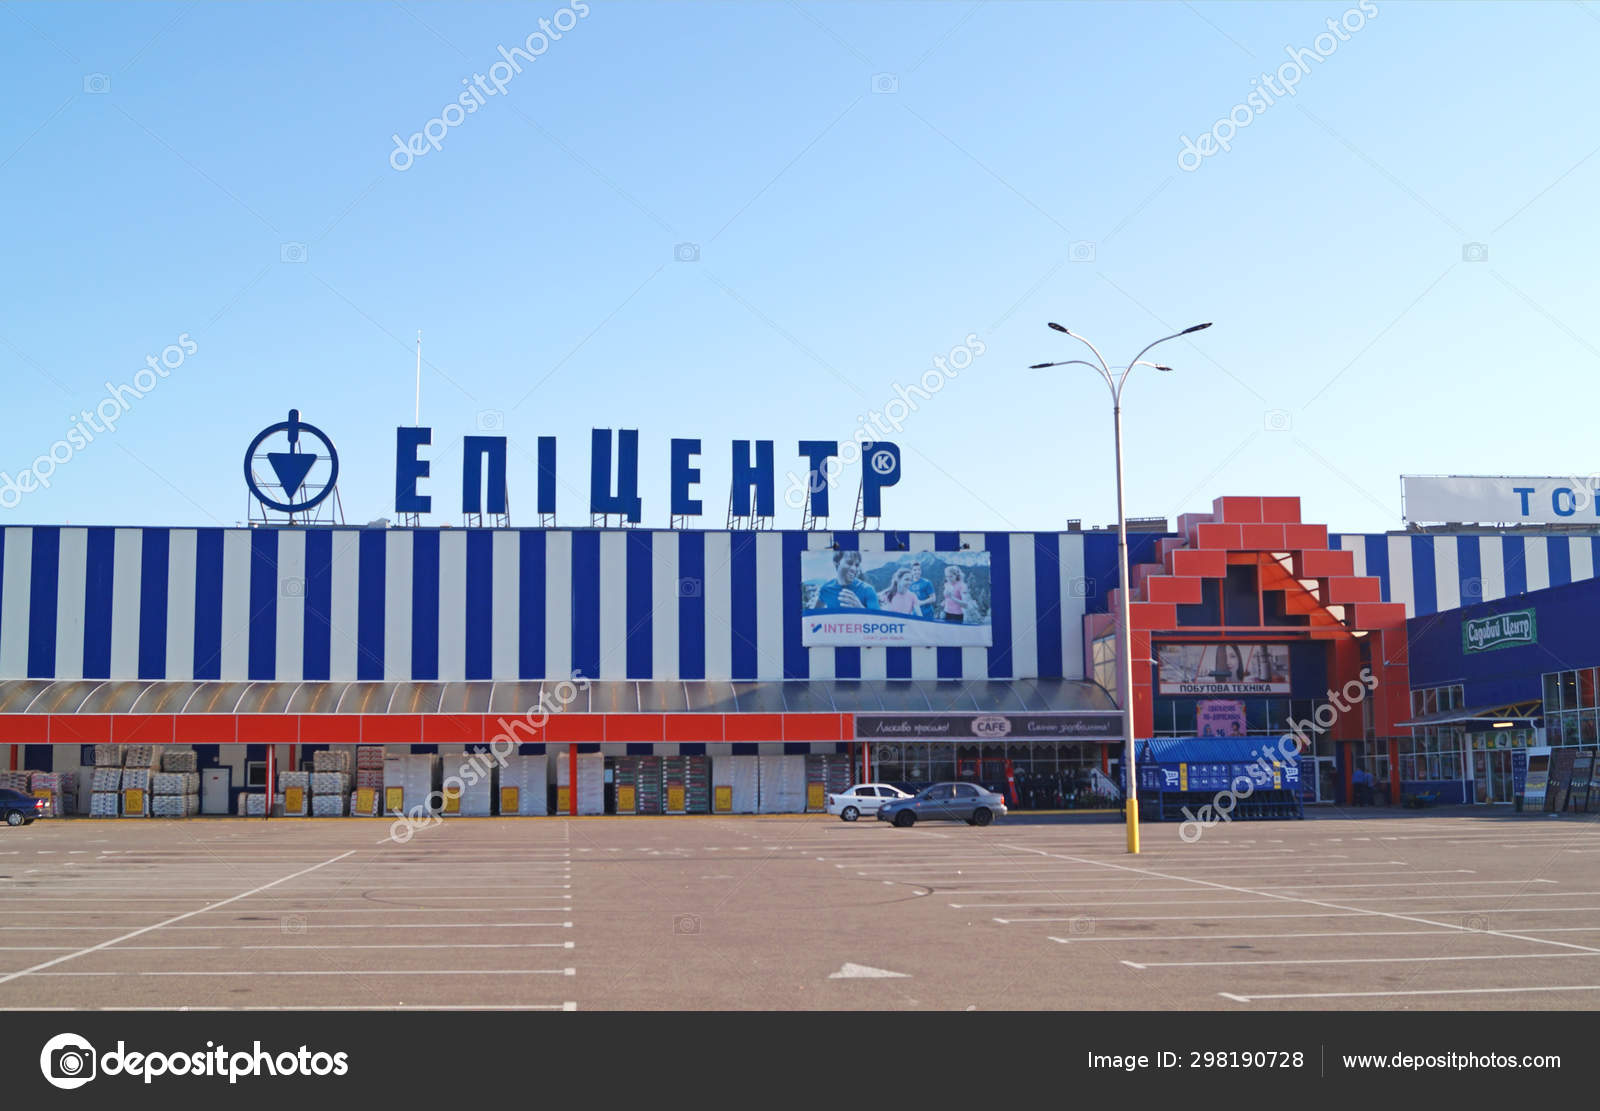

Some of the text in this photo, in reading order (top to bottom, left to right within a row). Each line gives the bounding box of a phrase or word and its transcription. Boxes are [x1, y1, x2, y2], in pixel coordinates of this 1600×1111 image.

[395, 427, 901, 523] ЕПІЦЕНТР
[824, 623, 906, 634] INTERSPORT
[1503, 616, 1529, 638] Центр
[1180, 684, 1272, 693] ПОБУТОВА ТЕХНІКА
[977, 722, 1006, 732] CAFE
